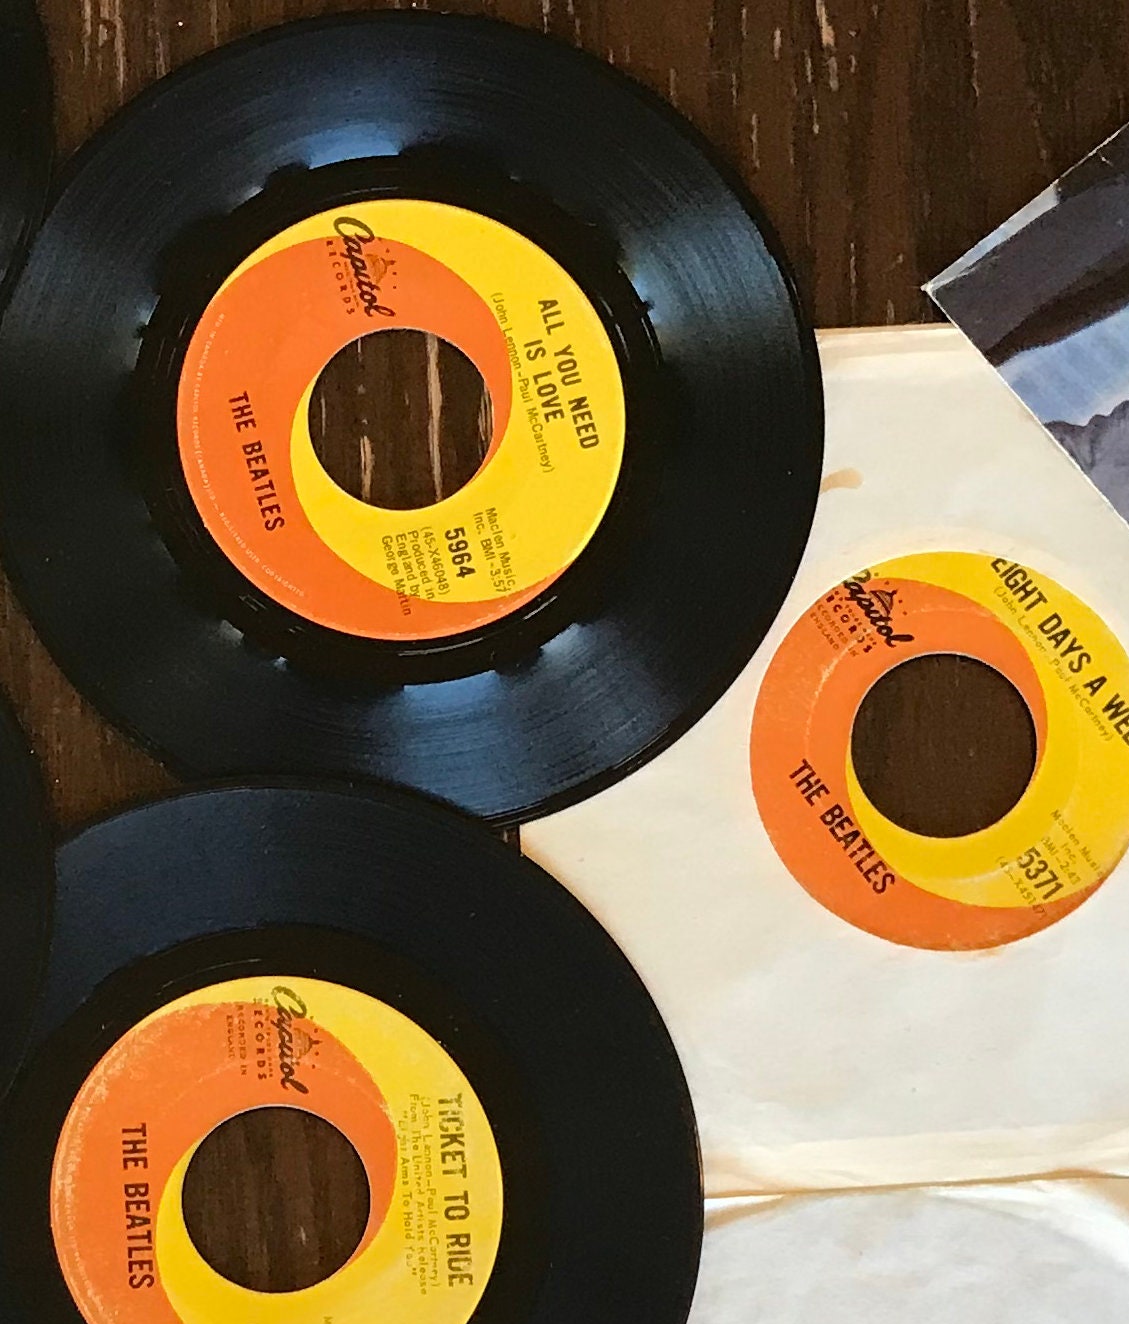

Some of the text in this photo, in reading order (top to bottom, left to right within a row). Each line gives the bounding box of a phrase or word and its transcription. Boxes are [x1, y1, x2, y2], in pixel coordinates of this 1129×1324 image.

[332, 217, 396, 317] Capitol
[228, 391, 257, 433] THE
[490, 292, 510, 325] (John
[525, 407, 555, 474] McCartney)
[523, 339, 565, 423] IS LOVE
[537, 299, 600, 450] ALL YOU NEED
[241, 440, 285, 532] BEATLES
[485, 507, 508, 549] Maclen
[381, 535, 412, 616] George Martin
[395, 533, 422, 598] England by
[408, 530, 435, 600] Produced in
[444, 527, 476, 579] 5964
[843, 568, 915, 649] Capitol
[1038, 612, 1091, 674] DAYS
[1082, 676, 1108, 697] A
[788, 758, 896, 895] THE BEATLES
[1015, 847, 1065, 901] 5371
[270, 986, 310, 1094] Capitol
[121, 1122, 155, 1289] THE BEATLES
[401, 1157, 414, 1240] Arms To Hold
[438, 1092, 473, 1288] TICKET TO RIDE
